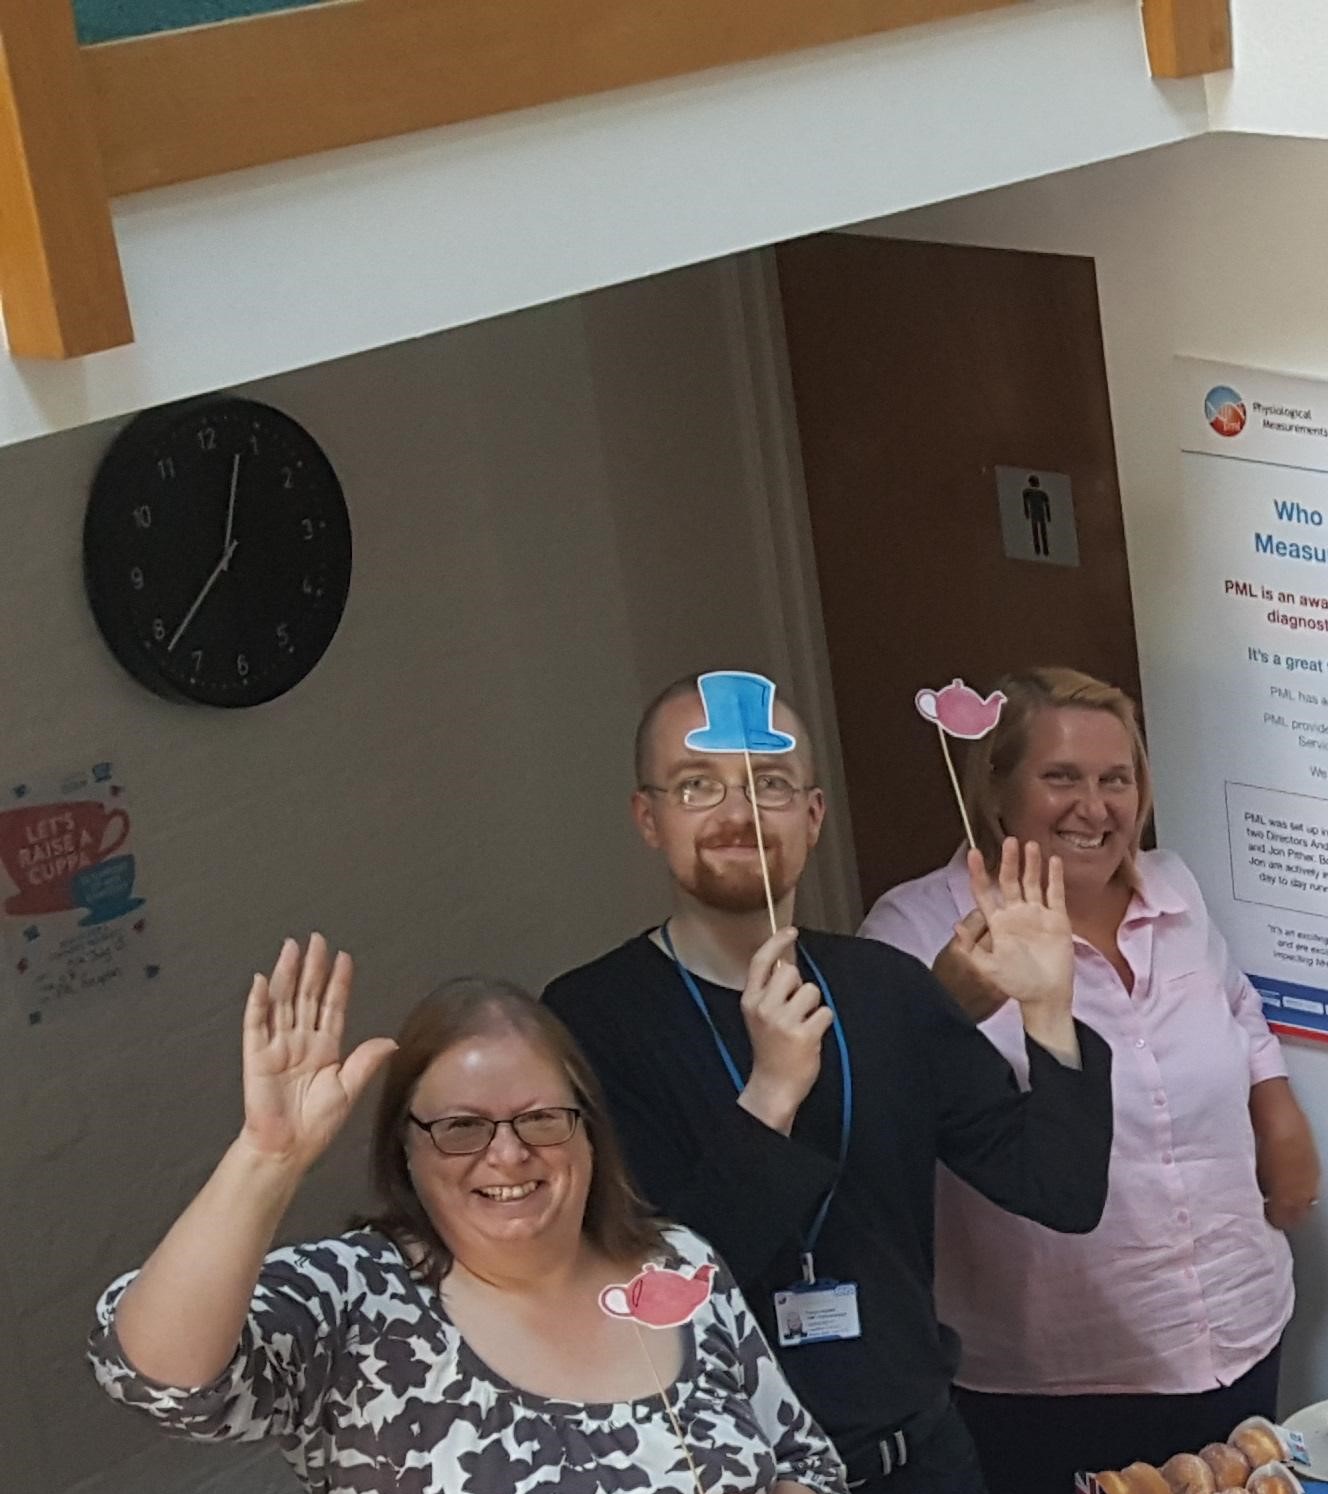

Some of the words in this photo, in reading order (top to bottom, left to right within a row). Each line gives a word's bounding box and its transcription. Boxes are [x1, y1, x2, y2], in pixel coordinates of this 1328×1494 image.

[199, 427, 217, 450] 12
[1262, 419, 1328, 437] Measurements
[251, 435, 260, 456] 1
[158, 457, 176, 480] 11
[281, 466, 294, 489] 2
[133, 504, 152, 529] 10
[1273, 499, 1321, 526] Who
[301, 518, 314, 540] 3
[131, 566, 144, 590] 9
[1225, 580, 1257, 597] PML
[1261, 586, 1273, 600] is
[1278, 592, 1295, 604] an
[152, 618, 166, 640] 8
[277, 622, 289, 646] 5
[191, 649, 203, 671] 7
[236, 653, 249, 676] 6
[1247, 647, 1269, 663] It's
[1273, 654, 1281, 665] a
[1285, 656, 1322, 672] great
[1269, 686, 1296, 701] PML
[1263, 711, 1289, 728] PML
[1309, 765, 1327, 779] We
[19, 833, 75, 868] RAISE
